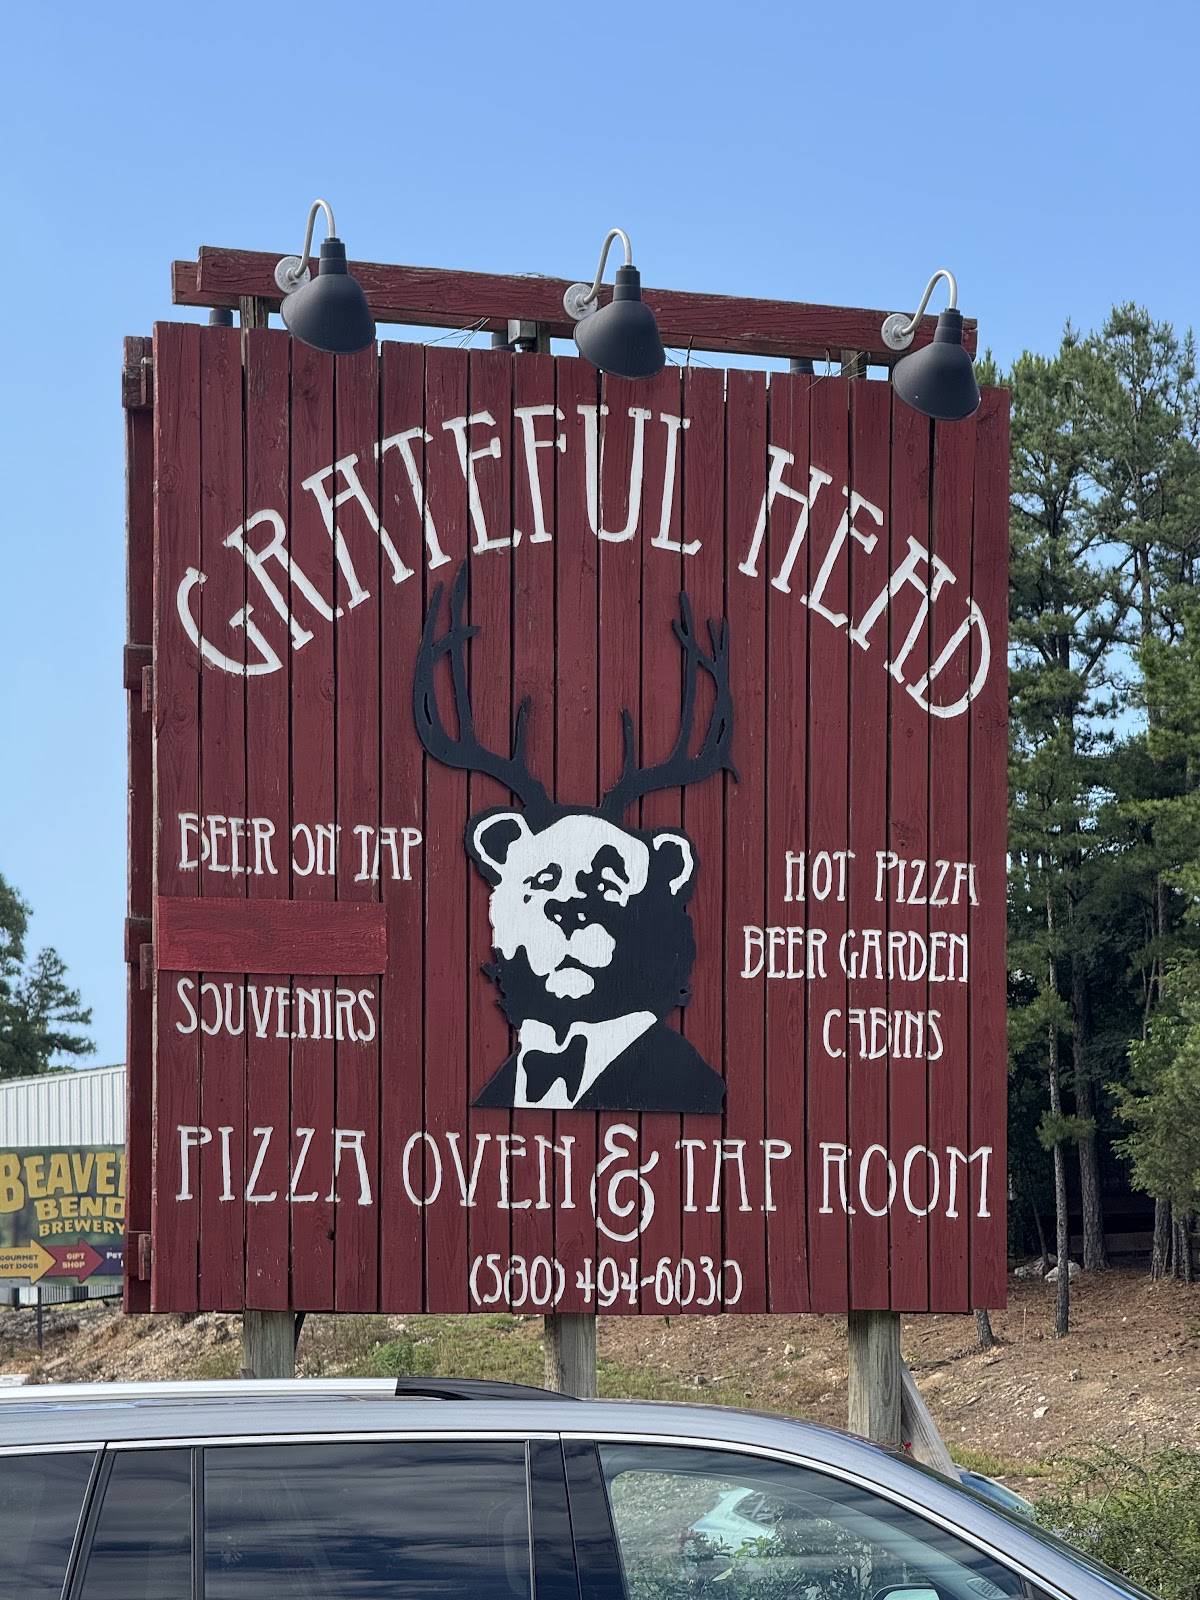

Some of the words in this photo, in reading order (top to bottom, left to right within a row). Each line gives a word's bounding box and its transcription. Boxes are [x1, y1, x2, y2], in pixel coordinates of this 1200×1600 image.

[177, 404, 702, 676] GRATEFUL
[738, 445, 992, 719] HEAD
[178, 812, 278, 875] BEER
[292, 823, 341, 876] ON
[353, 824, 423, 882] TAP
[783, 850, 856, 902] HOT
[874, 850, 980, 906] PIZZA
[740, 925, 828, 979] BEER
[839, 929, 968, 983] GARDEN
[175, 977, 377, 1042] SOUVENIRS
[822, 1007, 944, 1061] CABINS
[0, 1152, 125, 1214] BEAVE
[34, 1196, 126, 1221] BEND
[175, 1125, 373, 1206] PIZZA
[402, 1131, 577, 1209] OVEN
[590, 1123, 659, 1242] &
[674, 1138, 793, 1212] TAP
[818, 1143, 994, 1219] ROOM
[38, 1219, 125, 1237] BREWERY
[66, 1252, 85, 1260] GIFT
[62, 1261, 86, 1269] SHOP
[469, 1253, 566, 1307] (580)
[575, 1256, 743, 1306] 494-6030
